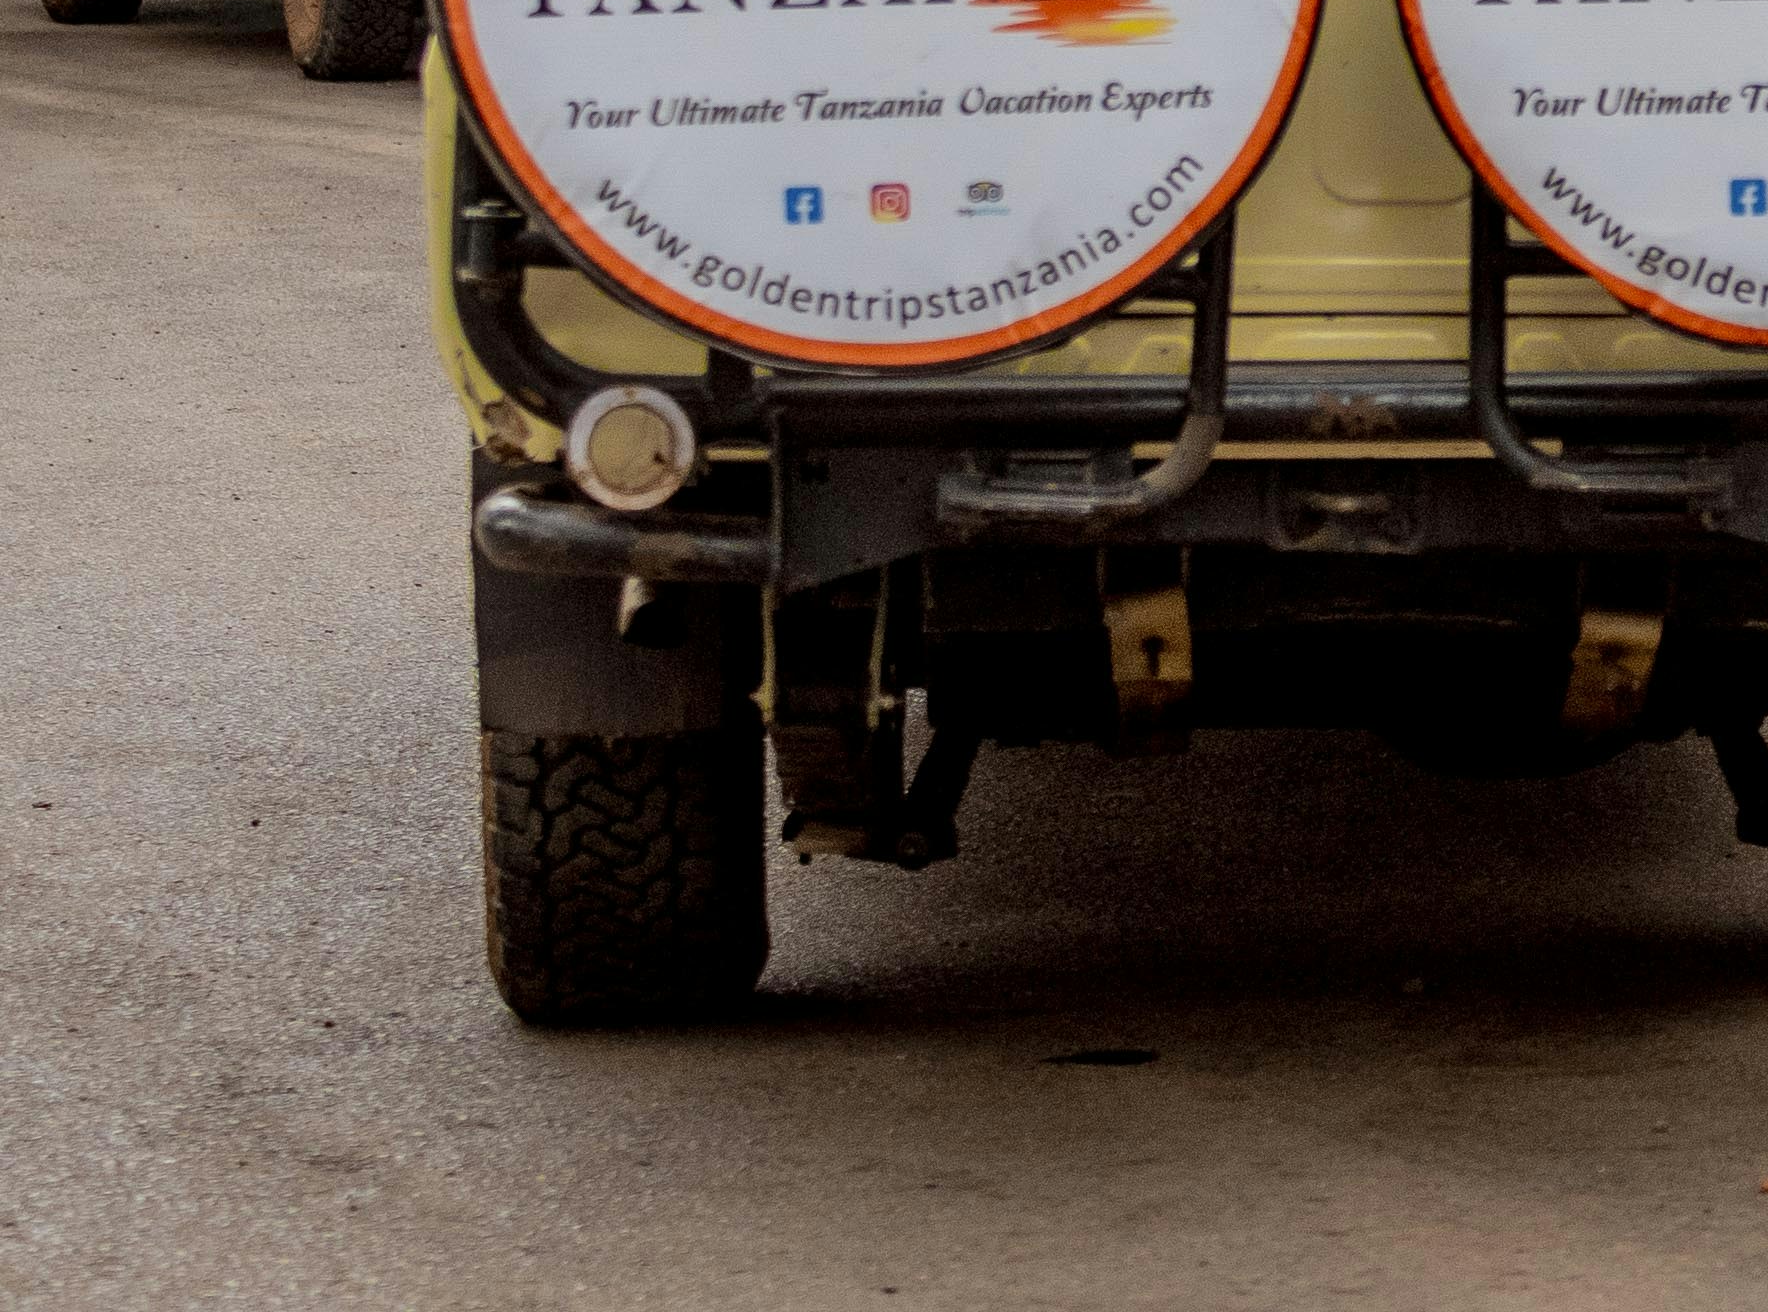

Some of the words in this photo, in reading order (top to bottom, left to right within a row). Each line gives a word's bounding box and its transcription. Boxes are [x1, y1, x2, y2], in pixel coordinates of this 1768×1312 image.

[566, 99, 641, 130] Your
[651, 96, 788, 127] Ultimate
[795, 88, 945, 122] Tanzania
[958, 84, 1093, 116] Vacation
[1100, 79, 1215, 122] Experts
[1513, 86, 1587, 118] Your
[1596, 83, 1733, 117] Ultimate
[596, 153, 1204, 328] www.goldentripstanzania.com
